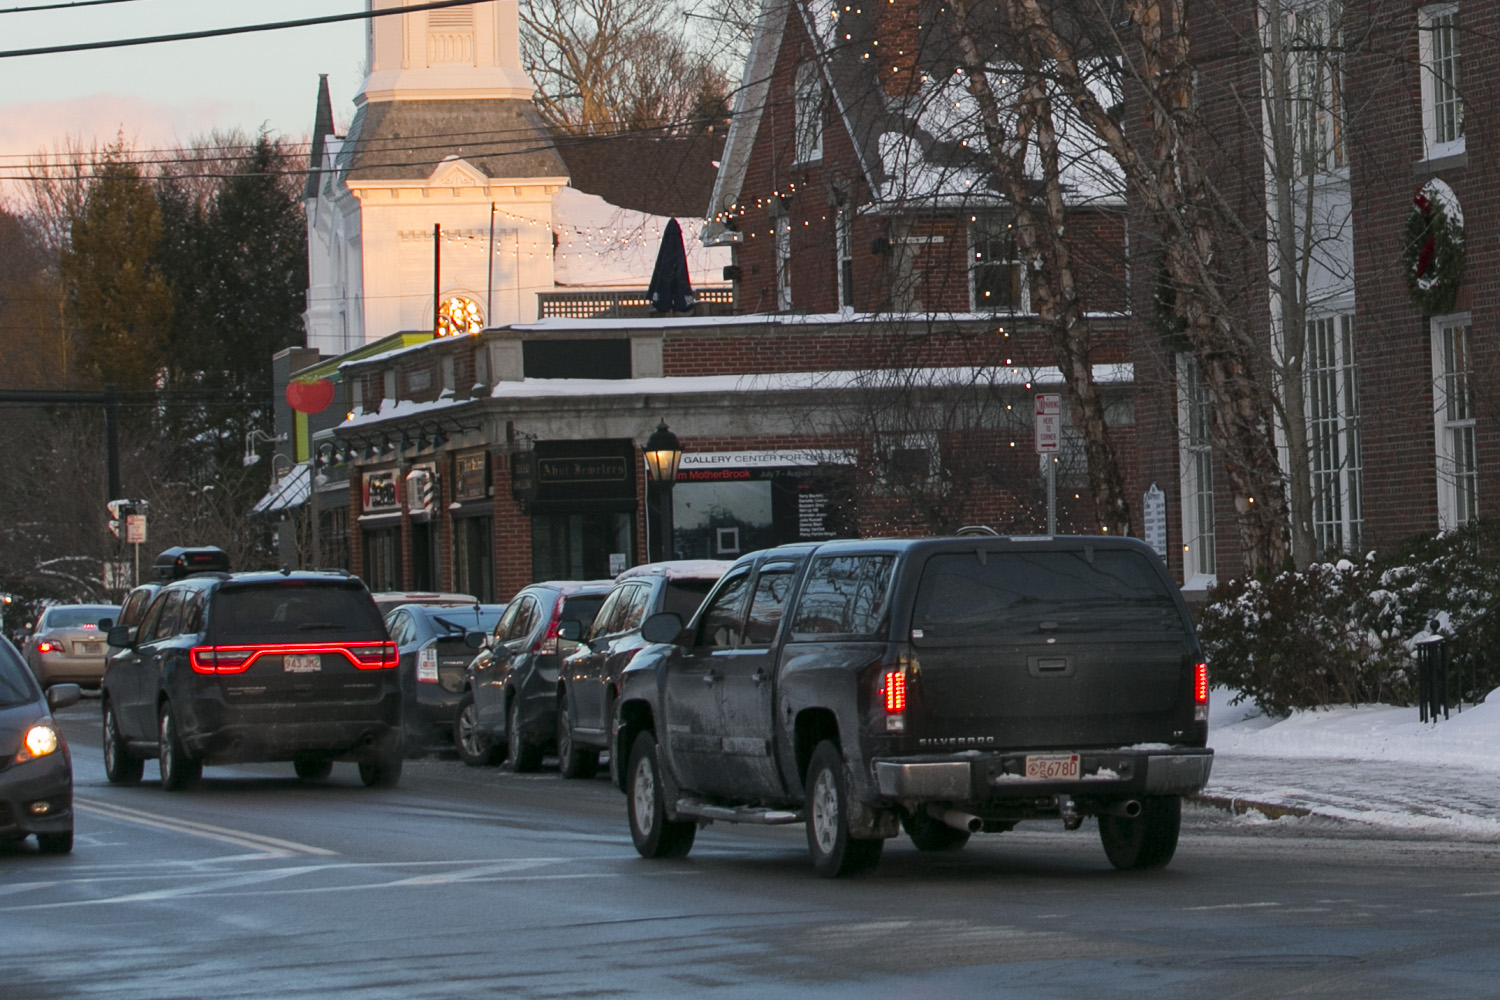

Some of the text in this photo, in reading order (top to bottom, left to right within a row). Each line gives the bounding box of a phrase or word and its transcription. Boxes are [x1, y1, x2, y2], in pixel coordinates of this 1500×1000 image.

[684, 455, 731, 464] GALLERY
[735, 454, 776, 463] CENTER
[780, 453, 801, 461] FOR
[689, 469, 750, 479] MotherBrook
[285, 659, 302, 669] 943
[919, 736, 994, 745] SILVERADO
[1047, 761, 1077, 777] 678D
